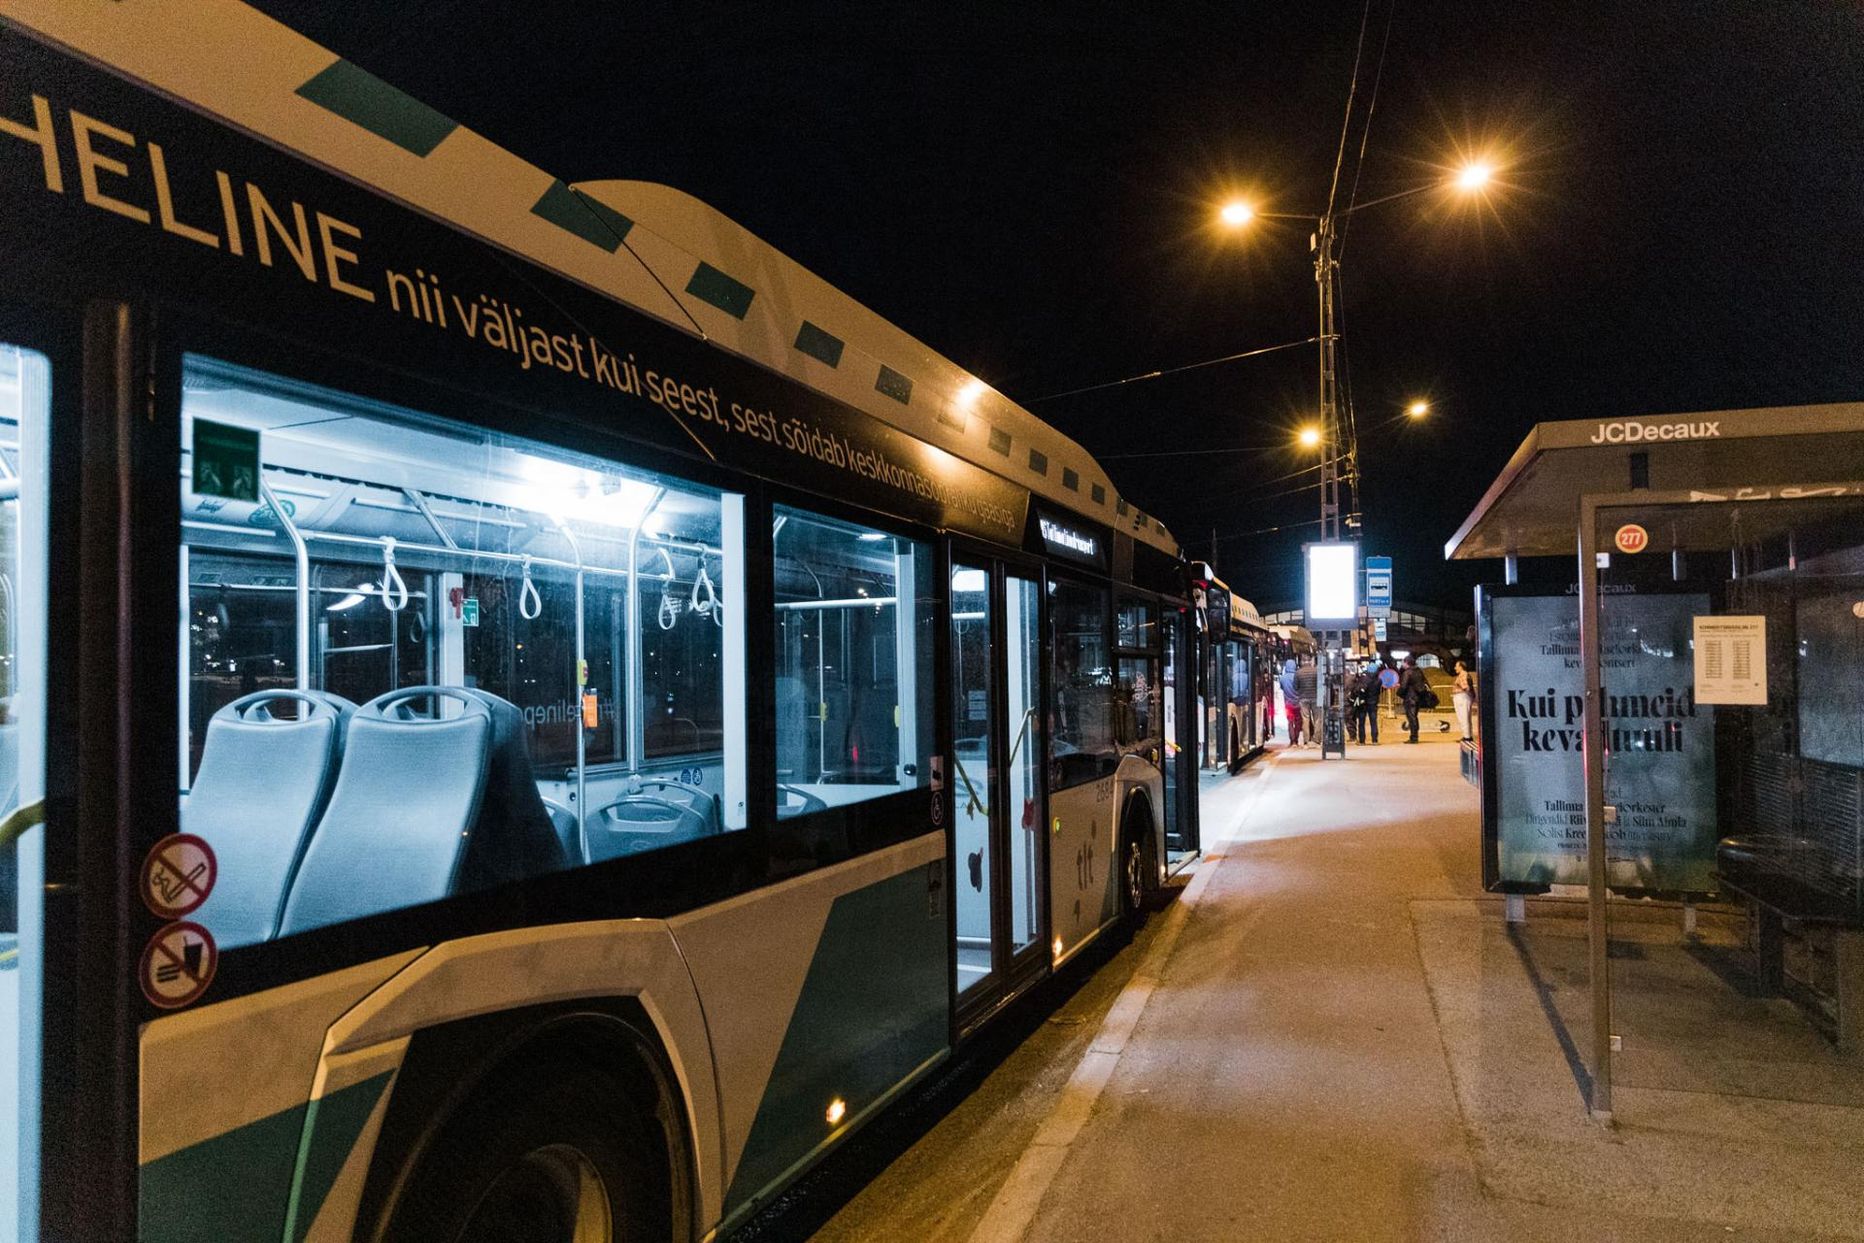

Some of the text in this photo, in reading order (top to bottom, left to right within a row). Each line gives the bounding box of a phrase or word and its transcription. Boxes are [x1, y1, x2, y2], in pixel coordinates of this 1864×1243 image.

[386, 268, 447, 329] nii
[452, 293, 590, 380] väljast
[590, 337, 642, 397] kui
[645, 370, 730, 432] seest,
[731, 402, 782, 446] sest
[782, 417, 846, 469] sõidab
[1591, 421, 1721, 445] JCDecaux
[1621, 532, 1642, 545] 277
[1507, 687, 1557, 719] Kui
